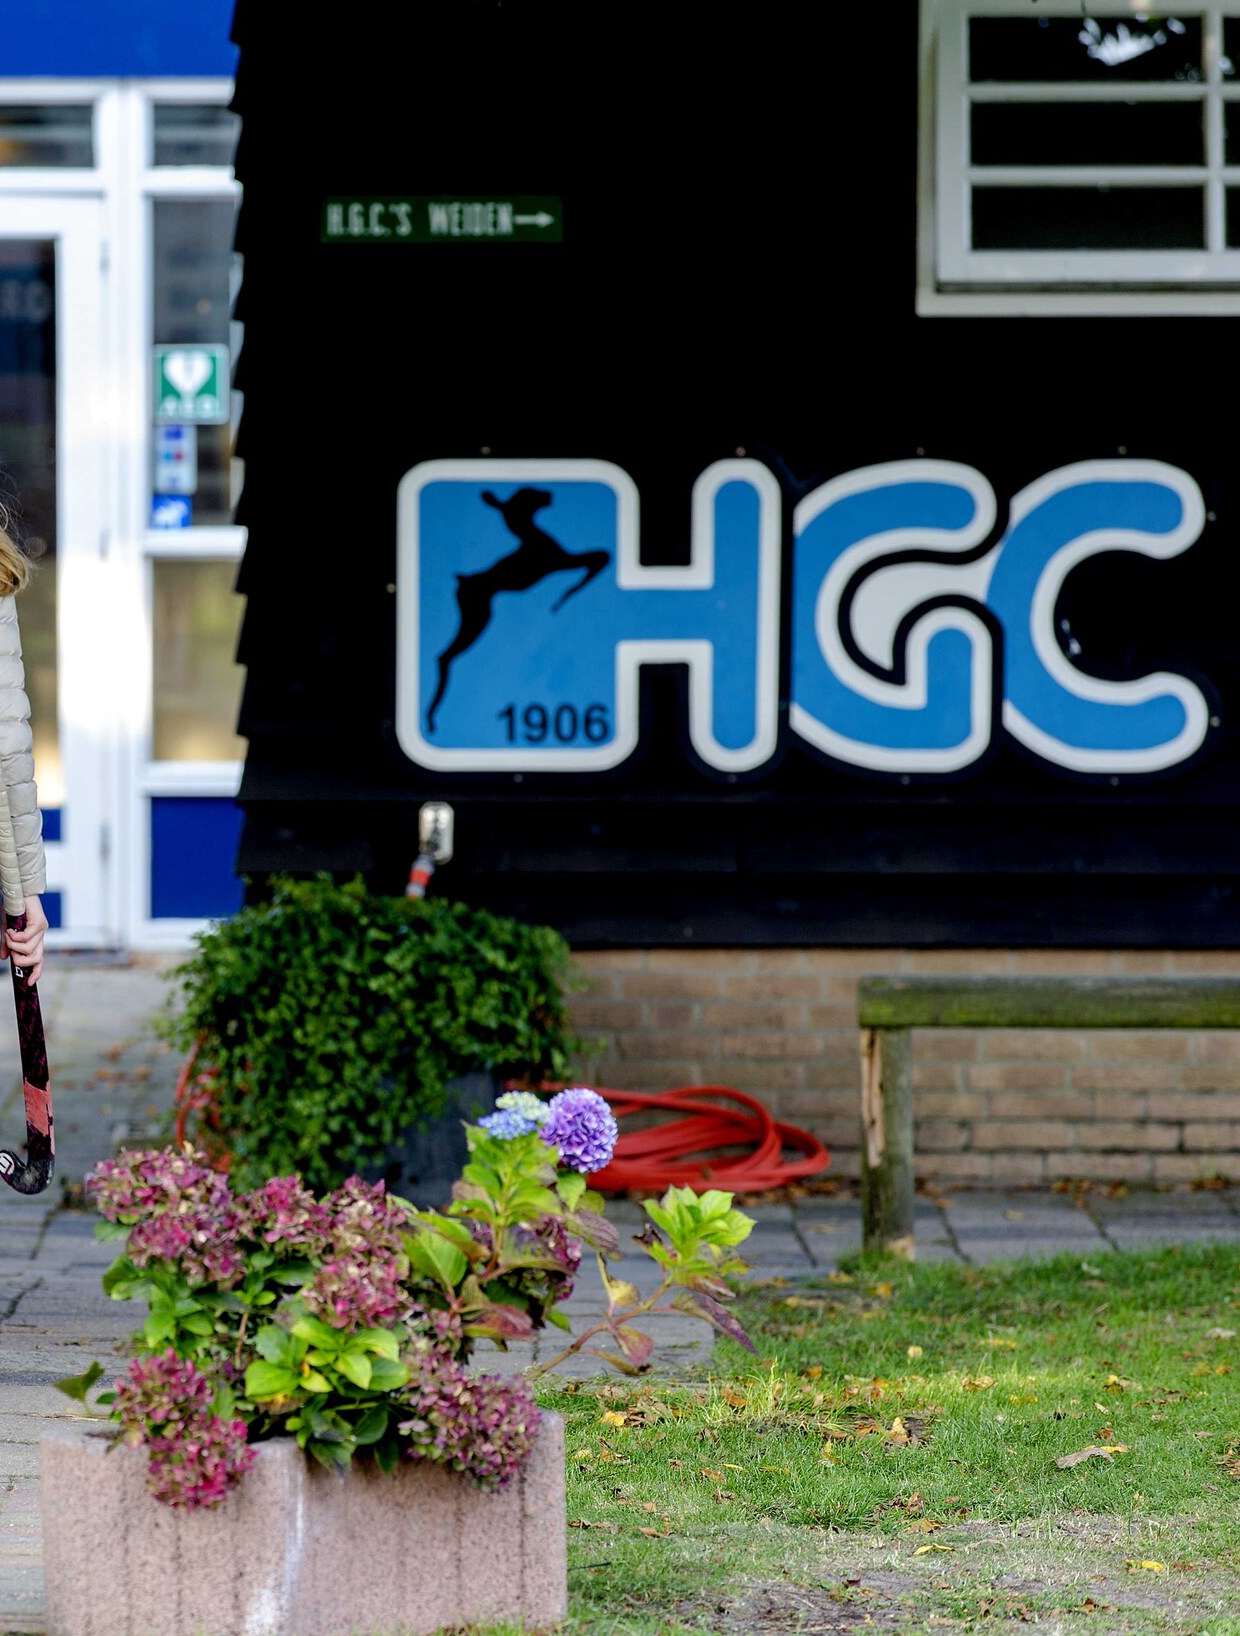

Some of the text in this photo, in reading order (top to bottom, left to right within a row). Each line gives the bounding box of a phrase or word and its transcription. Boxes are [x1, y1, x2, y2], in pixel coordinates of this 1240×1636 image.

[428, 202, 513, 236] WEIDEN
[397, 458, 1209, 773] HGC
[497, 703, 610, 743] 1906
